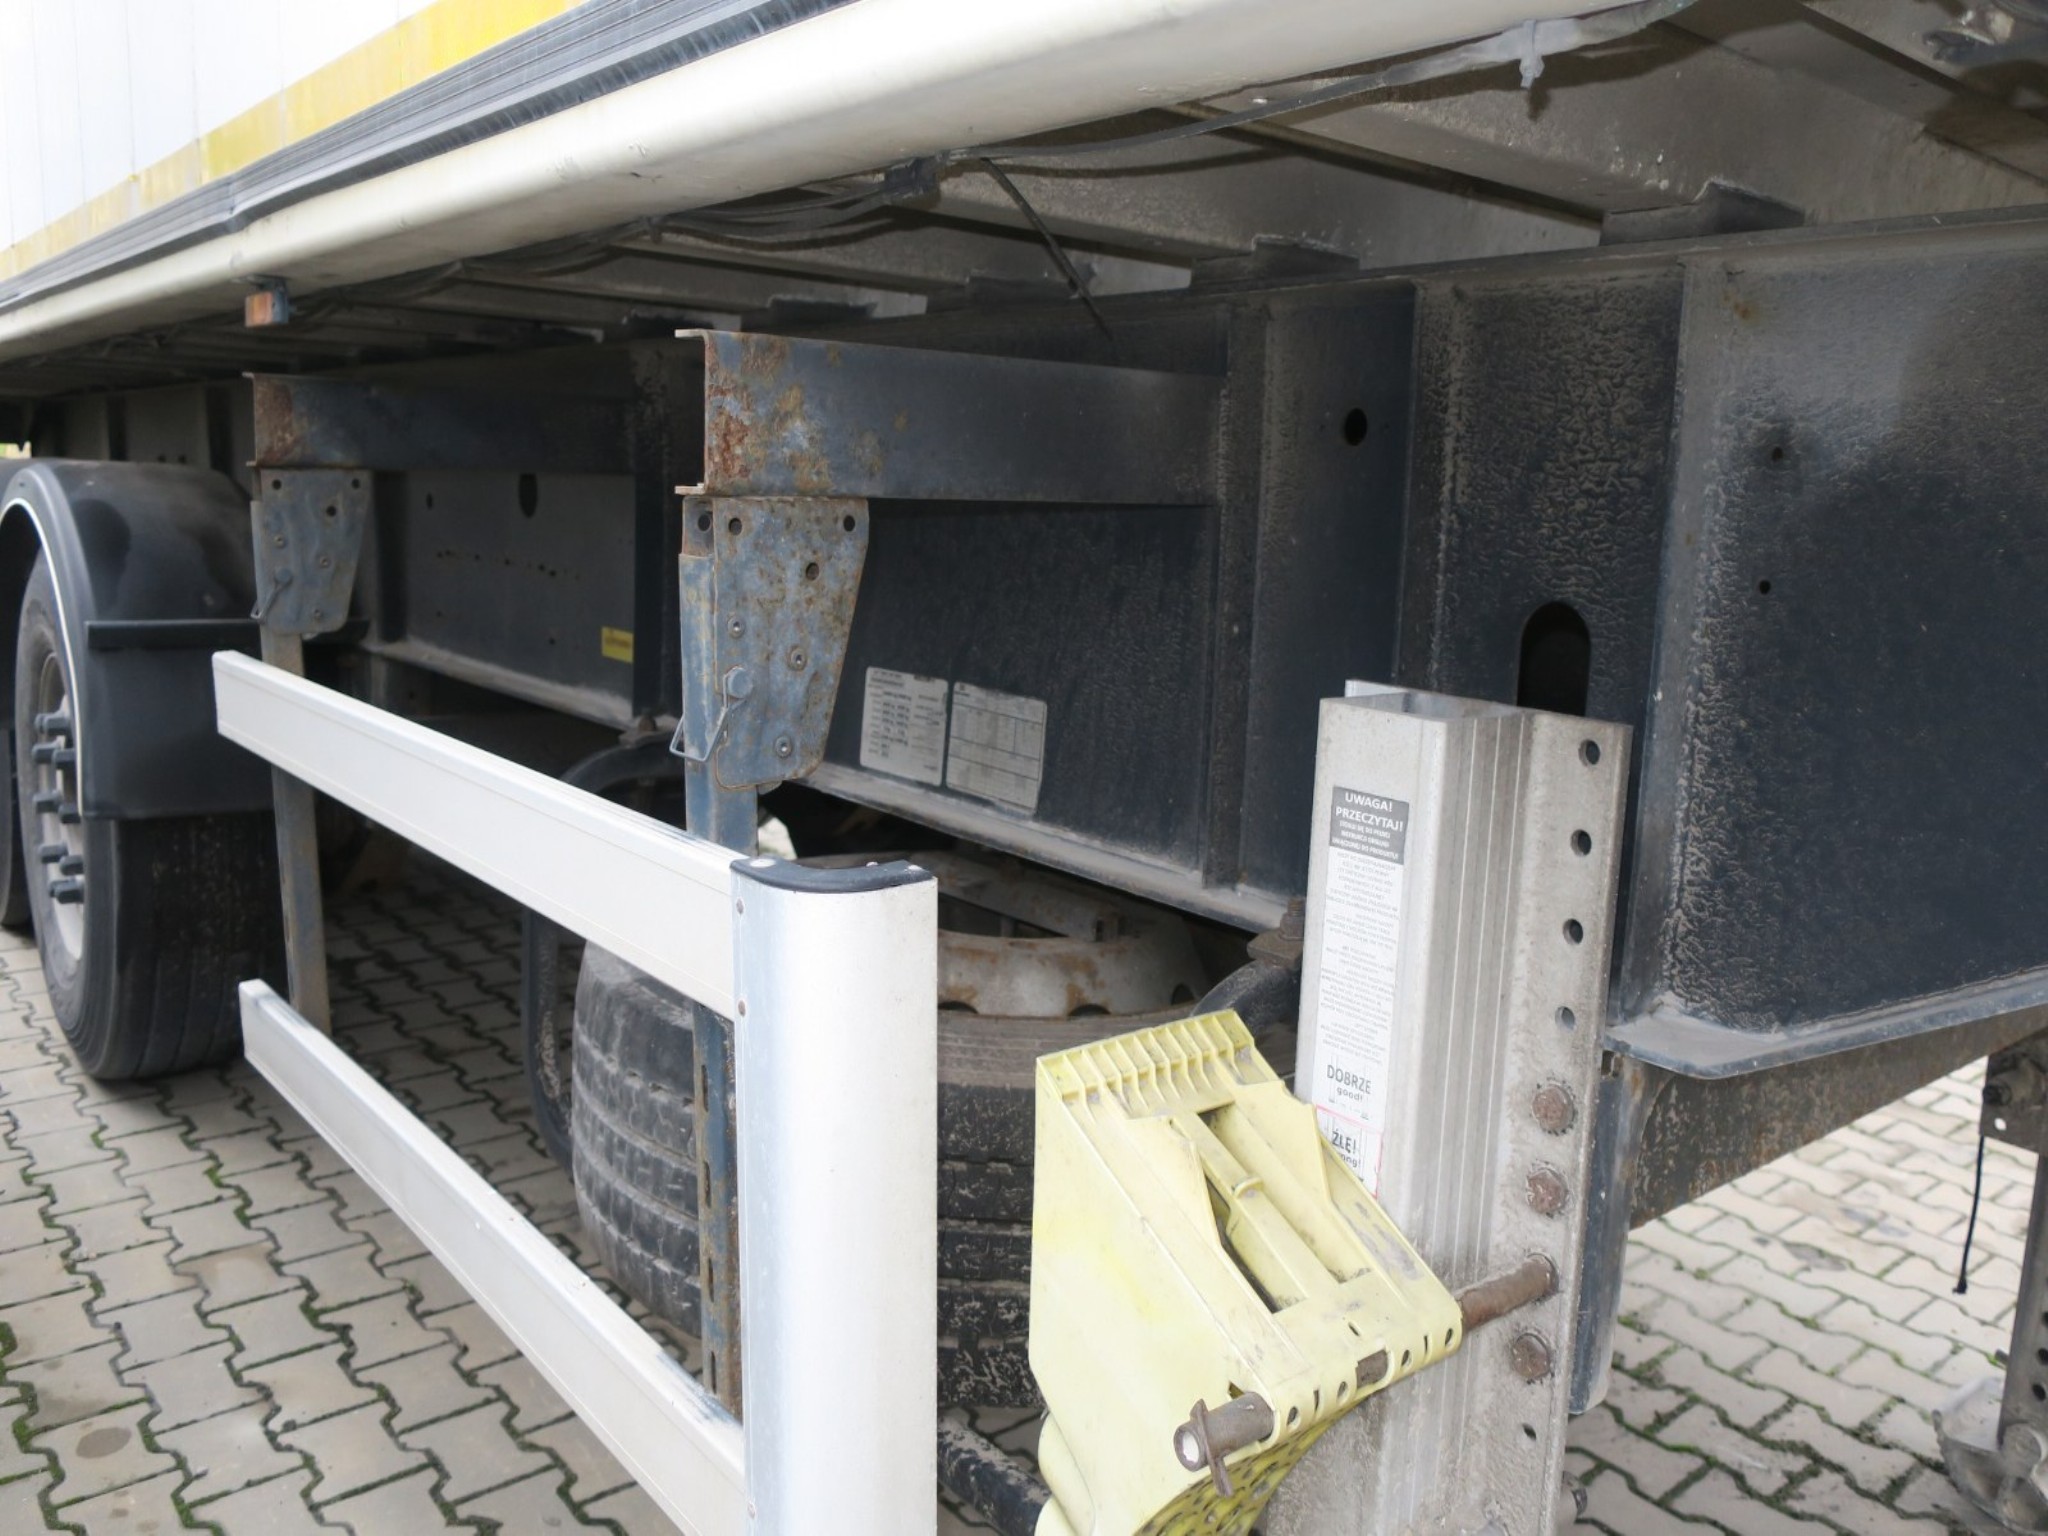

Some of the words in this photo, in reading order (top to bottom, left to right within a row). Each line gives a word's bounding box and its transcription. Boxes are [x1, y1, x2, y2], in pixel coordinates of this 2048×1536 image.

[1345, 792, 1393, 812] UWAGA!
[1335, 806, 1404, 832] PRZECZYTAJ!
[1326, 1064, 1372, 1095] DOBRZE
[1336, 1086, 1363, 1101] good!
